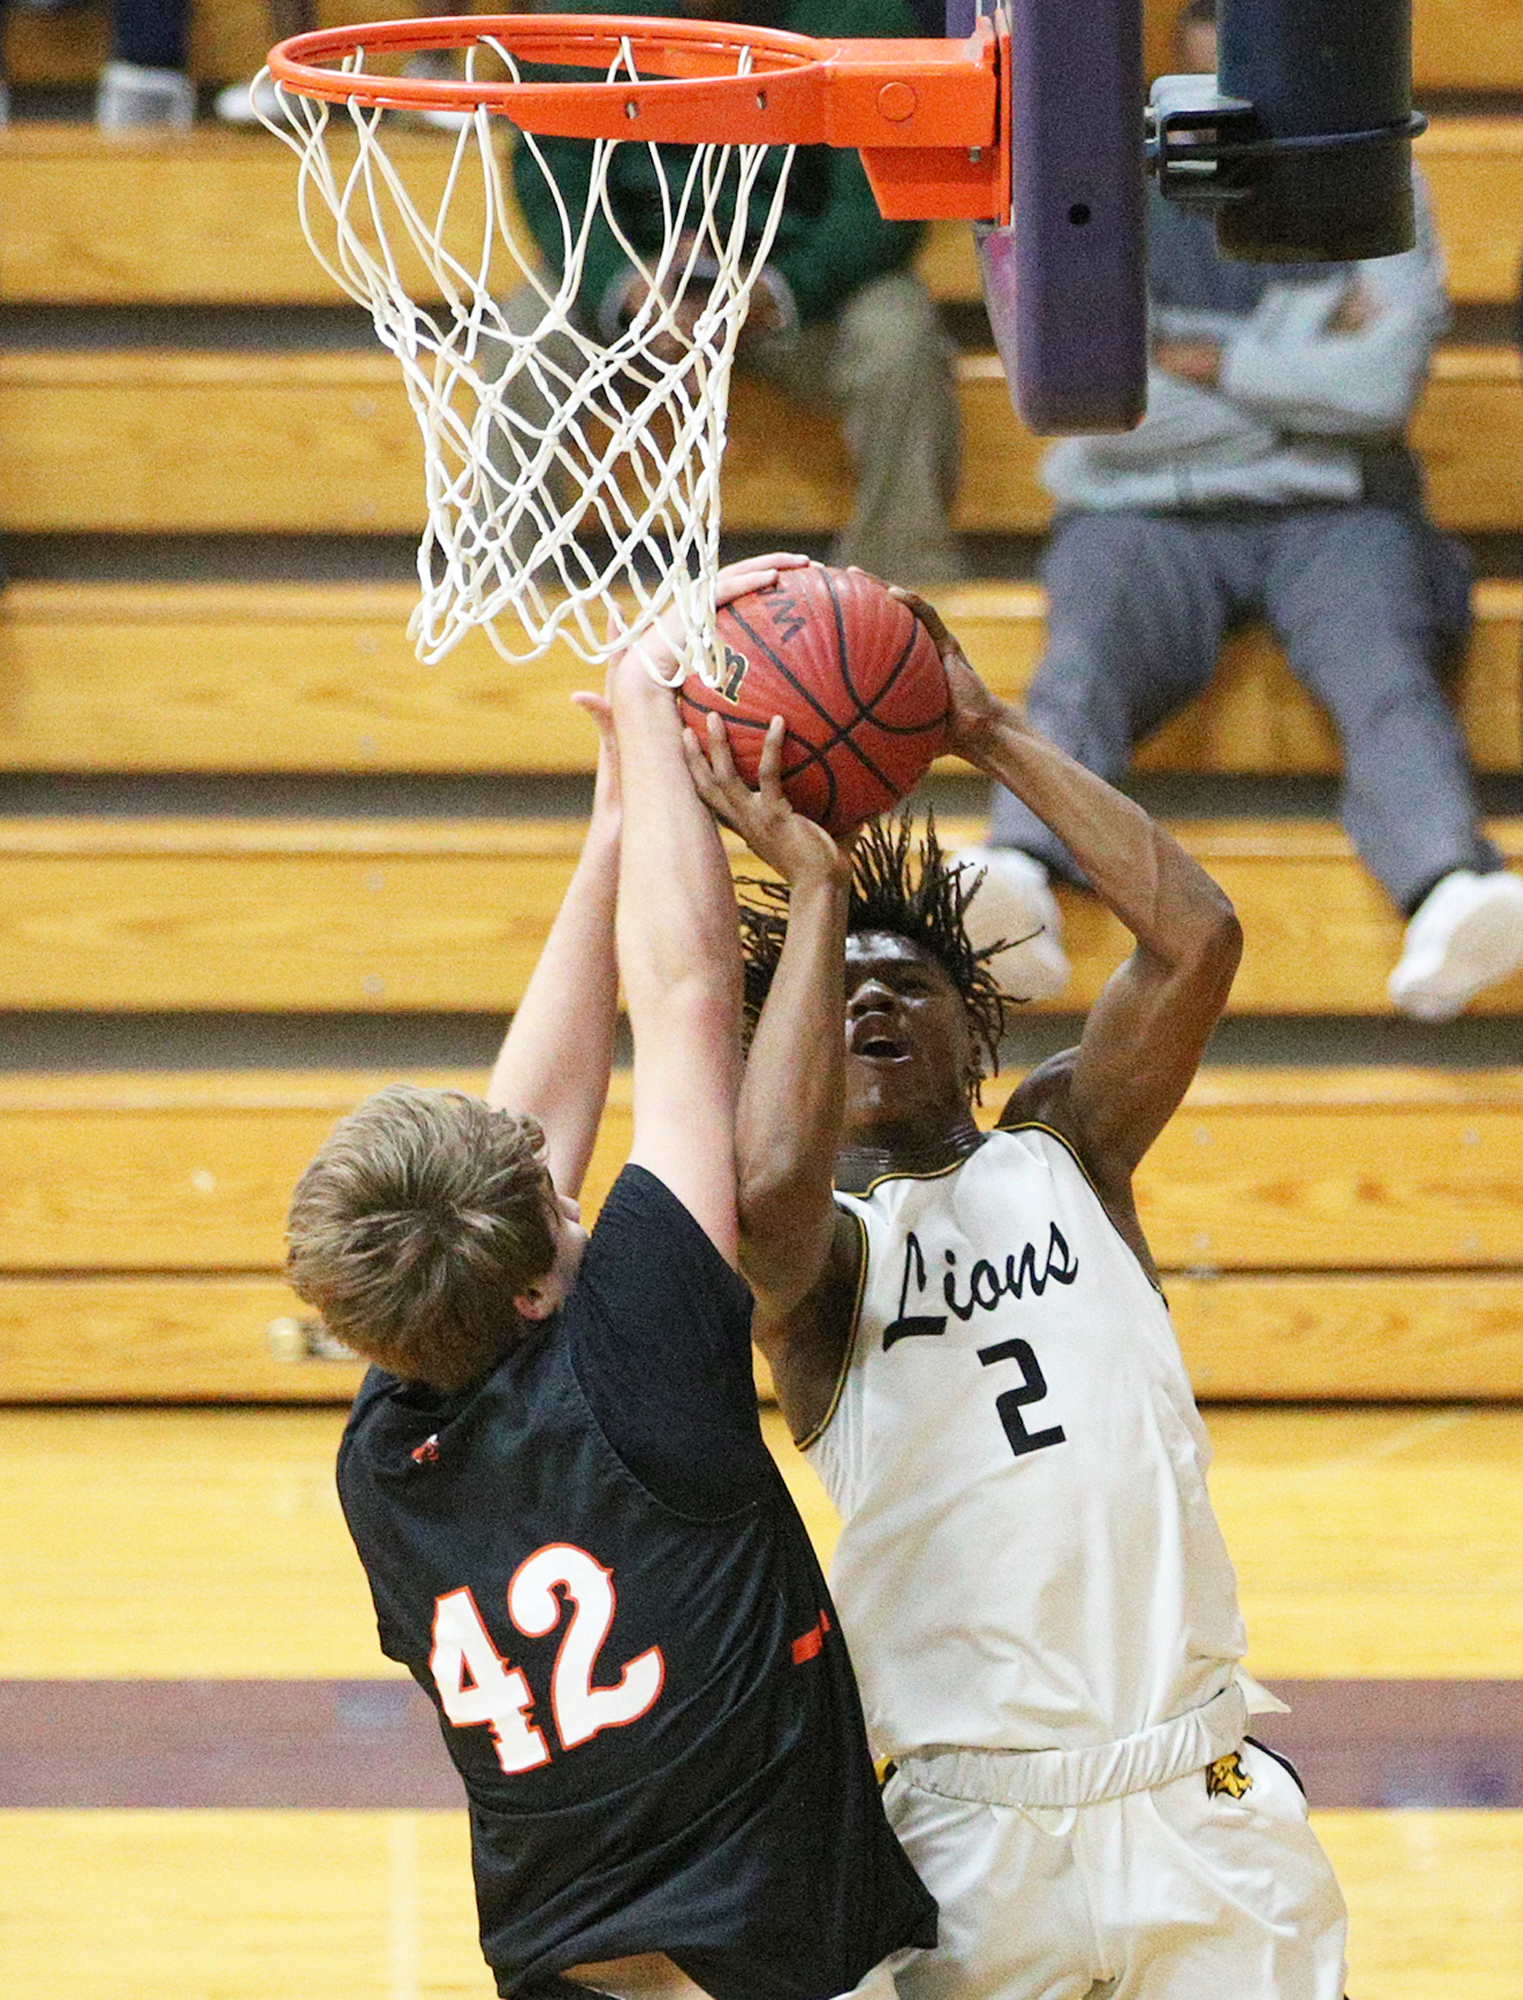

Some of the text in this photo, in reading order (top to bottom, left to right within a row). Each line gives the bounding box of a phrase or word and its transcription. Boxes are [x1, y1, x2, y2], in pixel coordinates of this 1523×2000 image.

[882, 1221, 1079, 1352] Lions
[976, 1338, 1067, 1457] 2
[428, 1541, 666, 1775] 42
